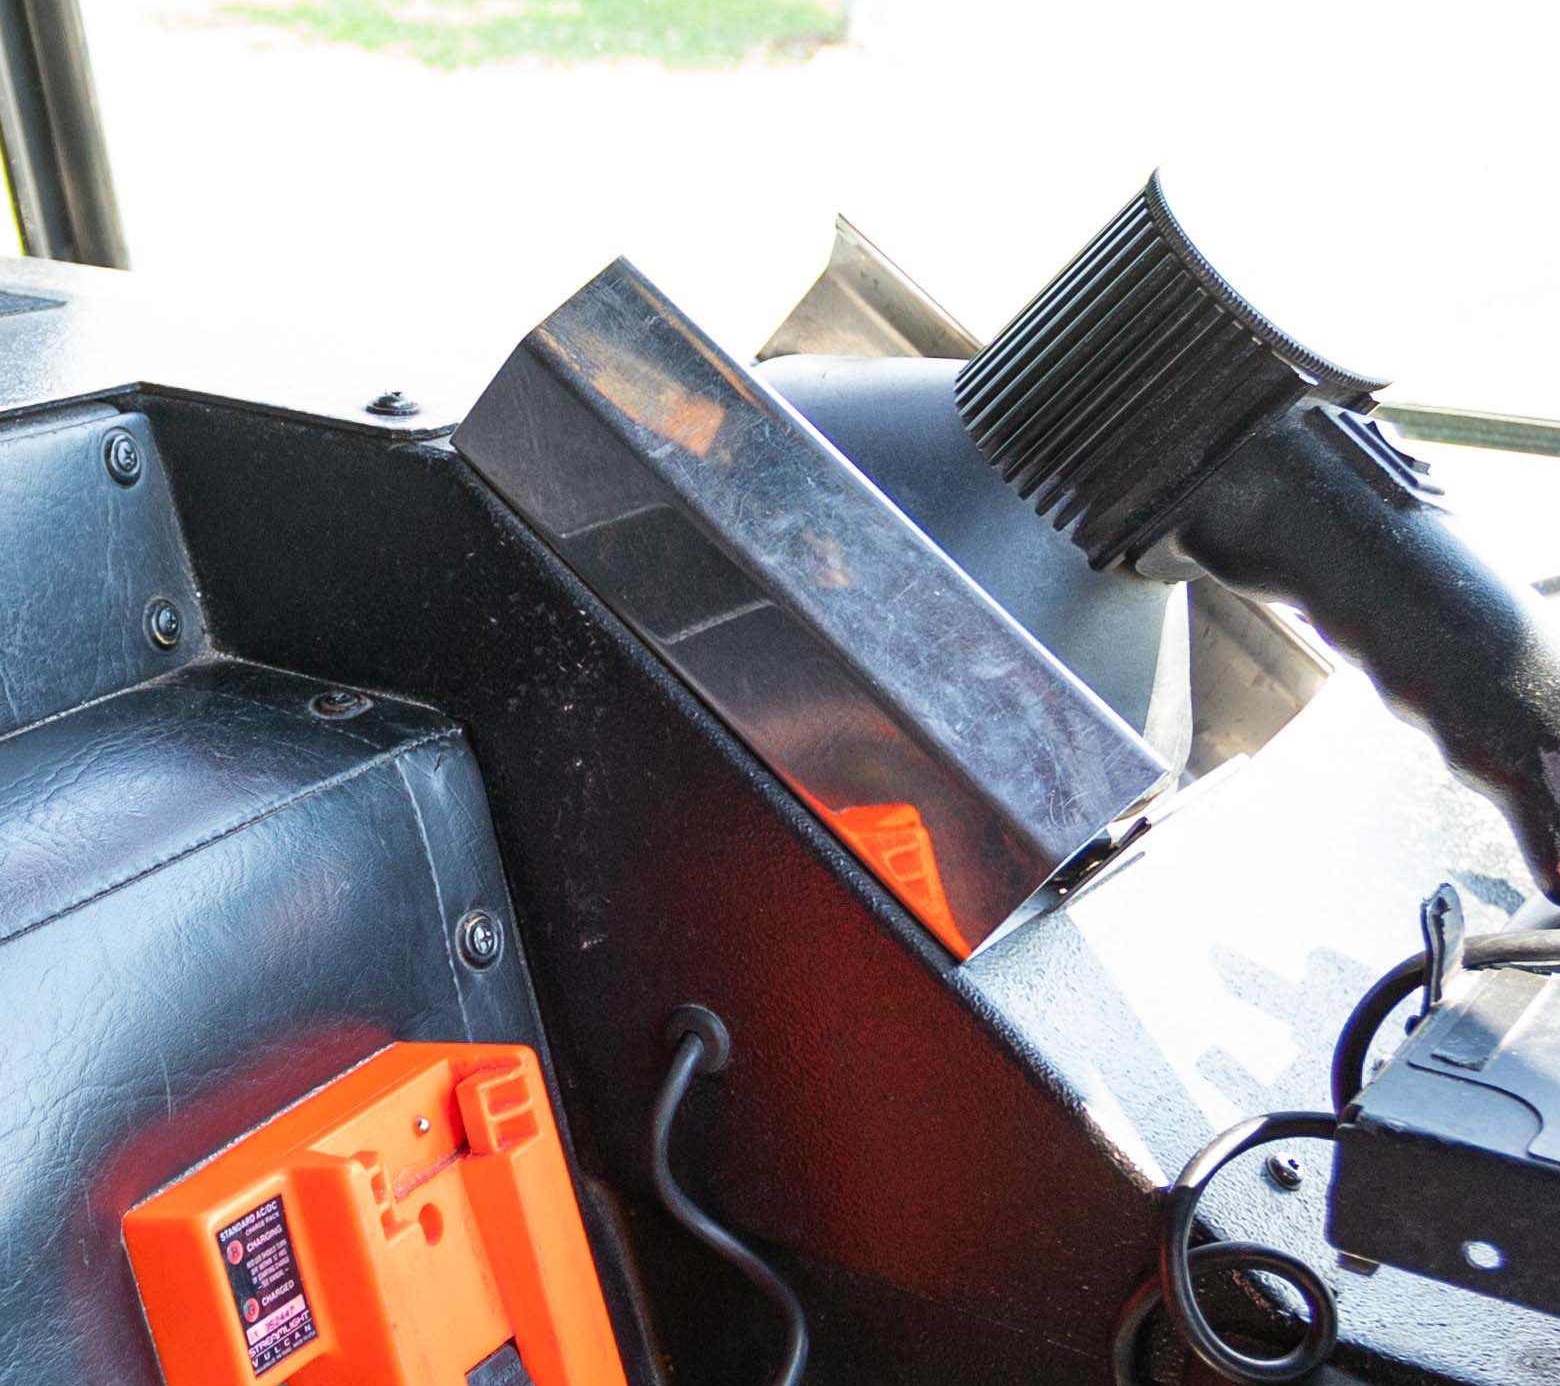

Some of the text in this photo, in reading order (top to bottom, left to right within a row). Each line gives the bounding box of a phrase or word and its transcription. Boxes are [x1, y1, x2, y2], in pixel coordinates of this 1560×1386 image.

[219, 1212, 255, 1242] STANDARD
[245, 1223, 282, 1253] CHARGING
[260, 1278, 294, 1307] CHARGED
[248, 1309, 310, 1358] STREAMLIGHT
